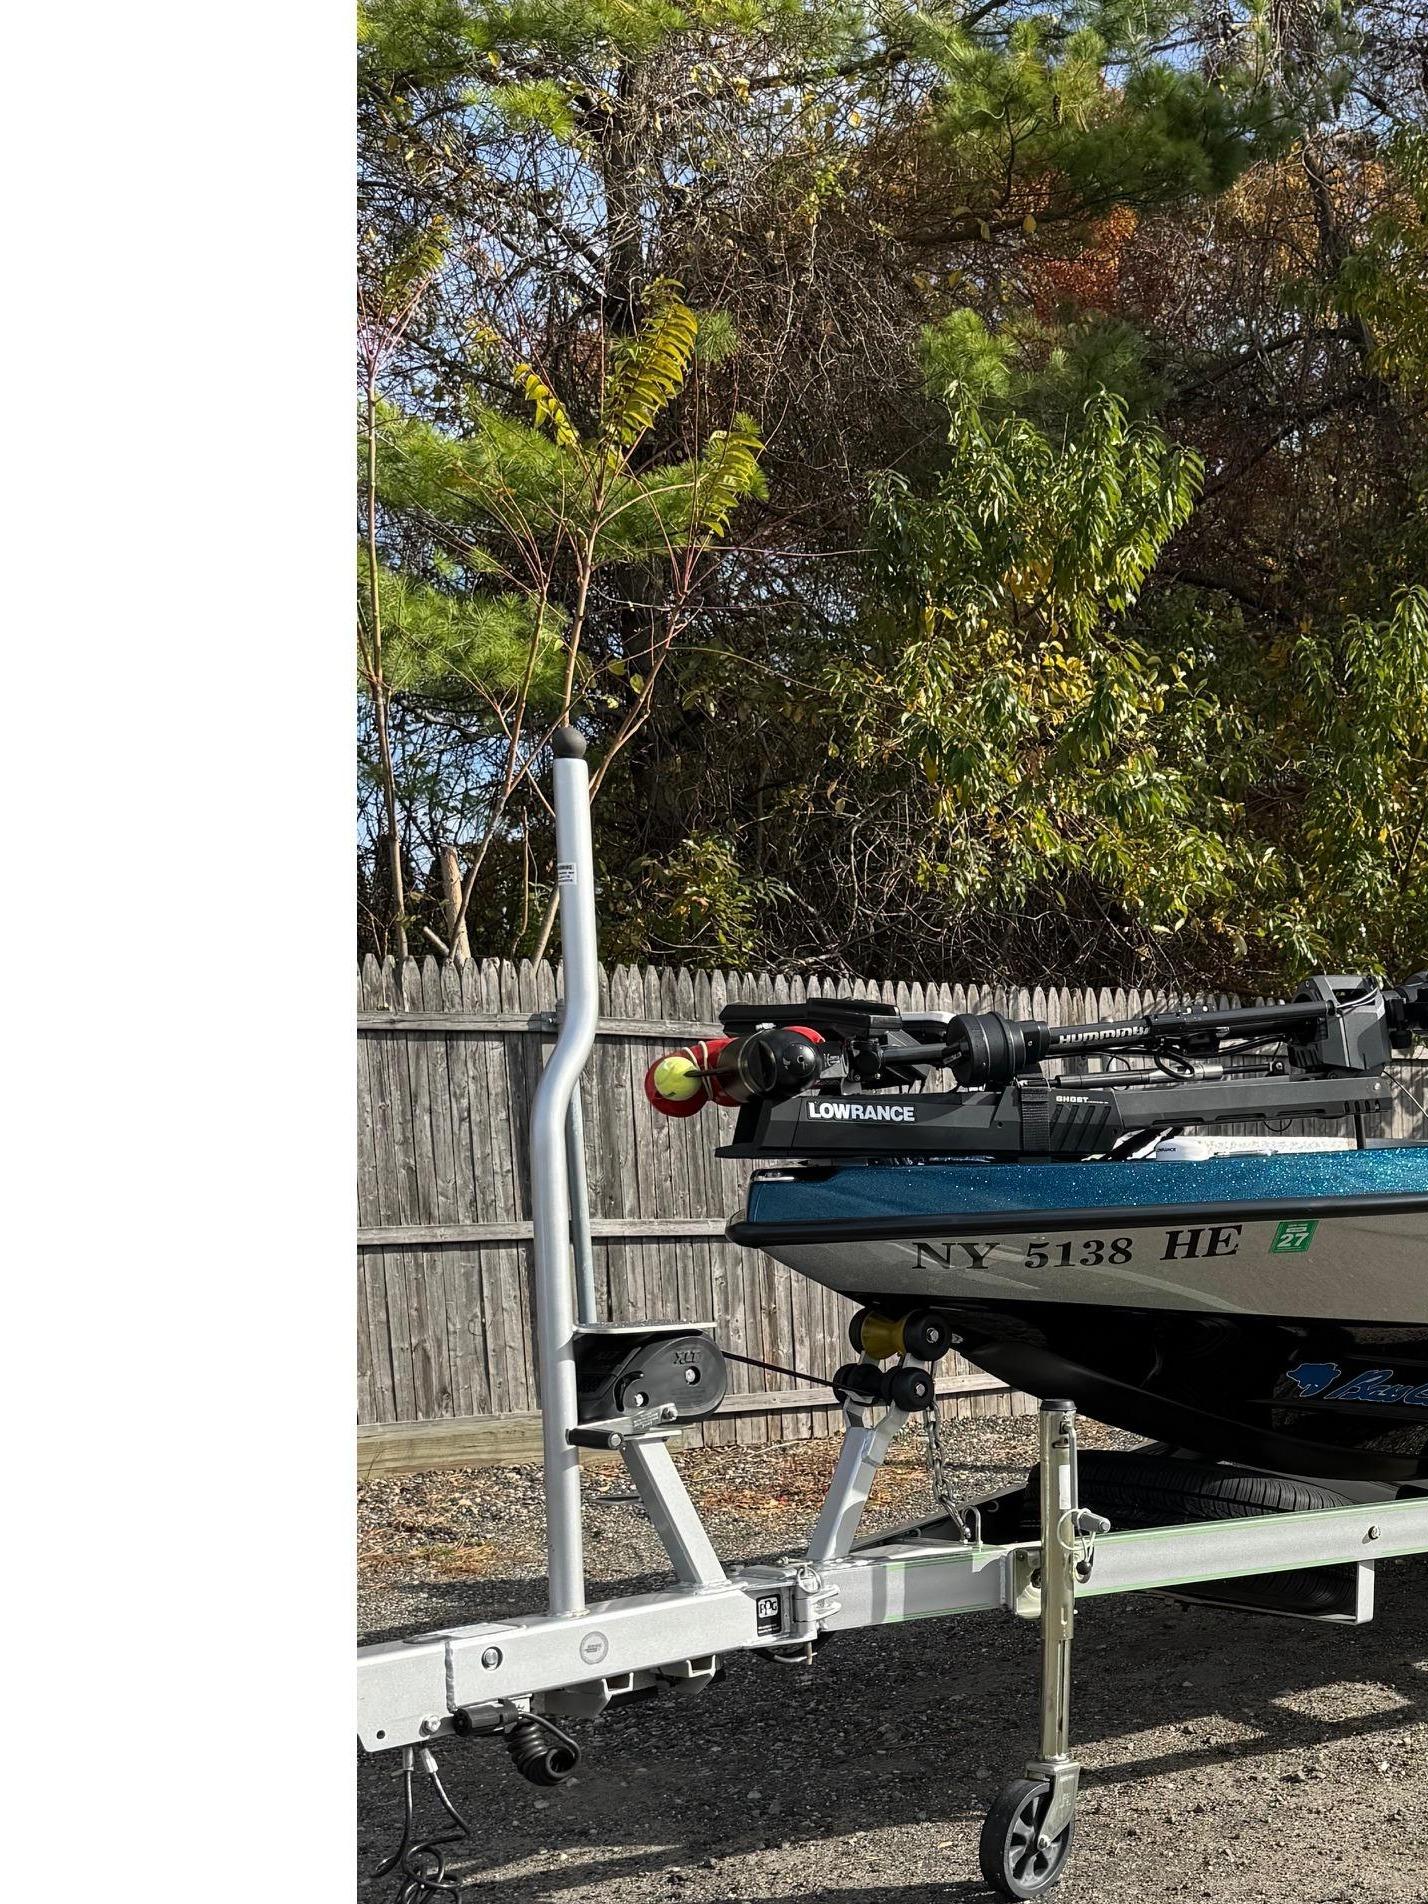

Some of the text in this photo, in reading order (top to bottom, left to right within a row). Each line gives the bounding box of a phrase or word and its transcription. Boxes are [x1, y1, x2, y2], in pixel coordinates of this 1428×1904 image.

[1055, 1095, 1089, 1103] GHOST
[807, 1101, 915, 1122] LOWRANCE
[911, 1224, 1243, 1270] NY 5138 HE
[1276, 1232, 1310, 1248] 27
[1323, 1369, 1414, 1403] Bass
